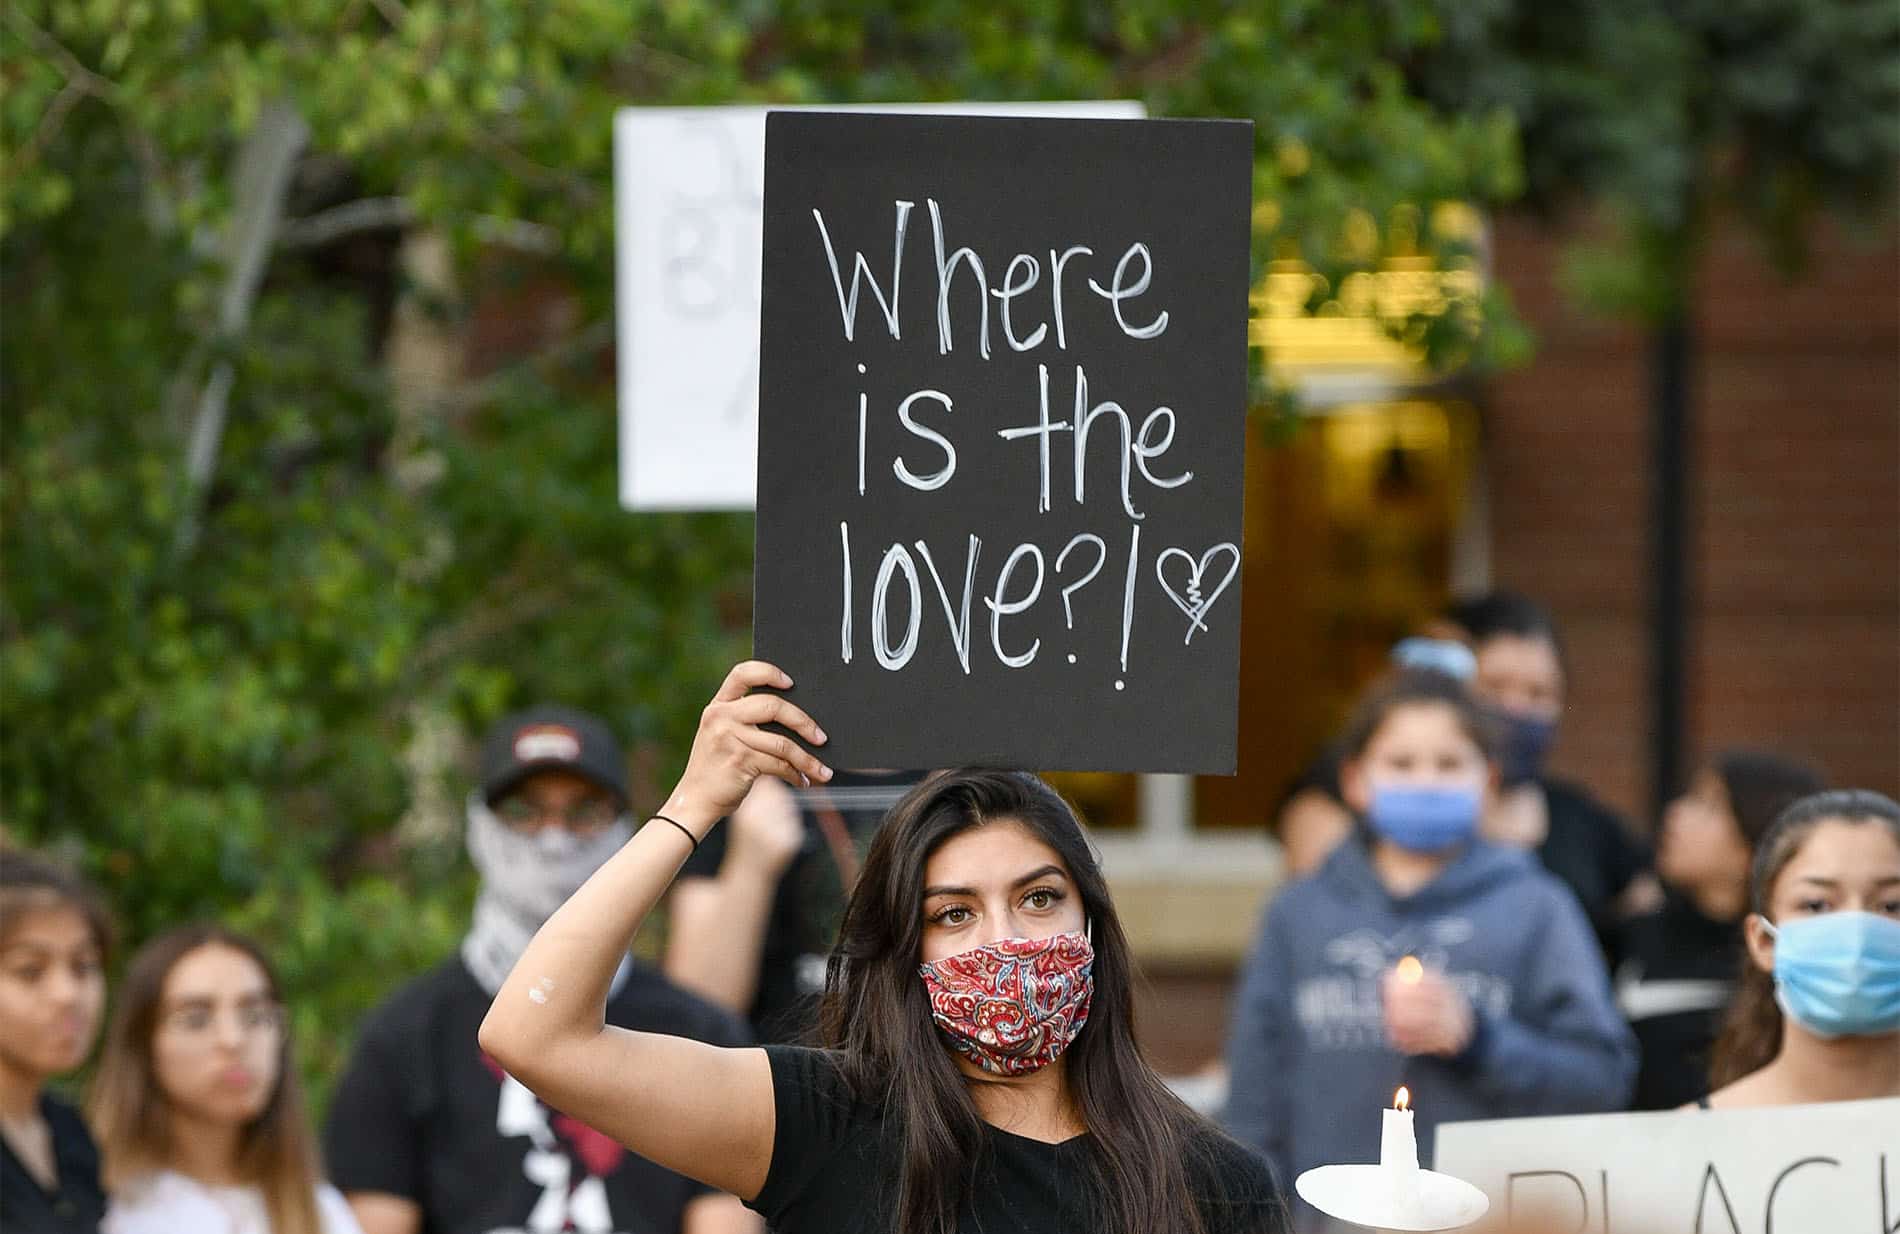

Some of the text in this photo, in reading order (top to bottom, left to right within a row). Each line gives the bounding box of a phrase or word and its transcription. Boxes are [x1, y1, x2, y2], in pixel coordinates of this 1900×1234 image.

[812, 198, 1168, 359] Where
[857, 363, 957, 497] is
[998, 364, 1194, 519] the
[839, 521, 1142, 690] love?!
